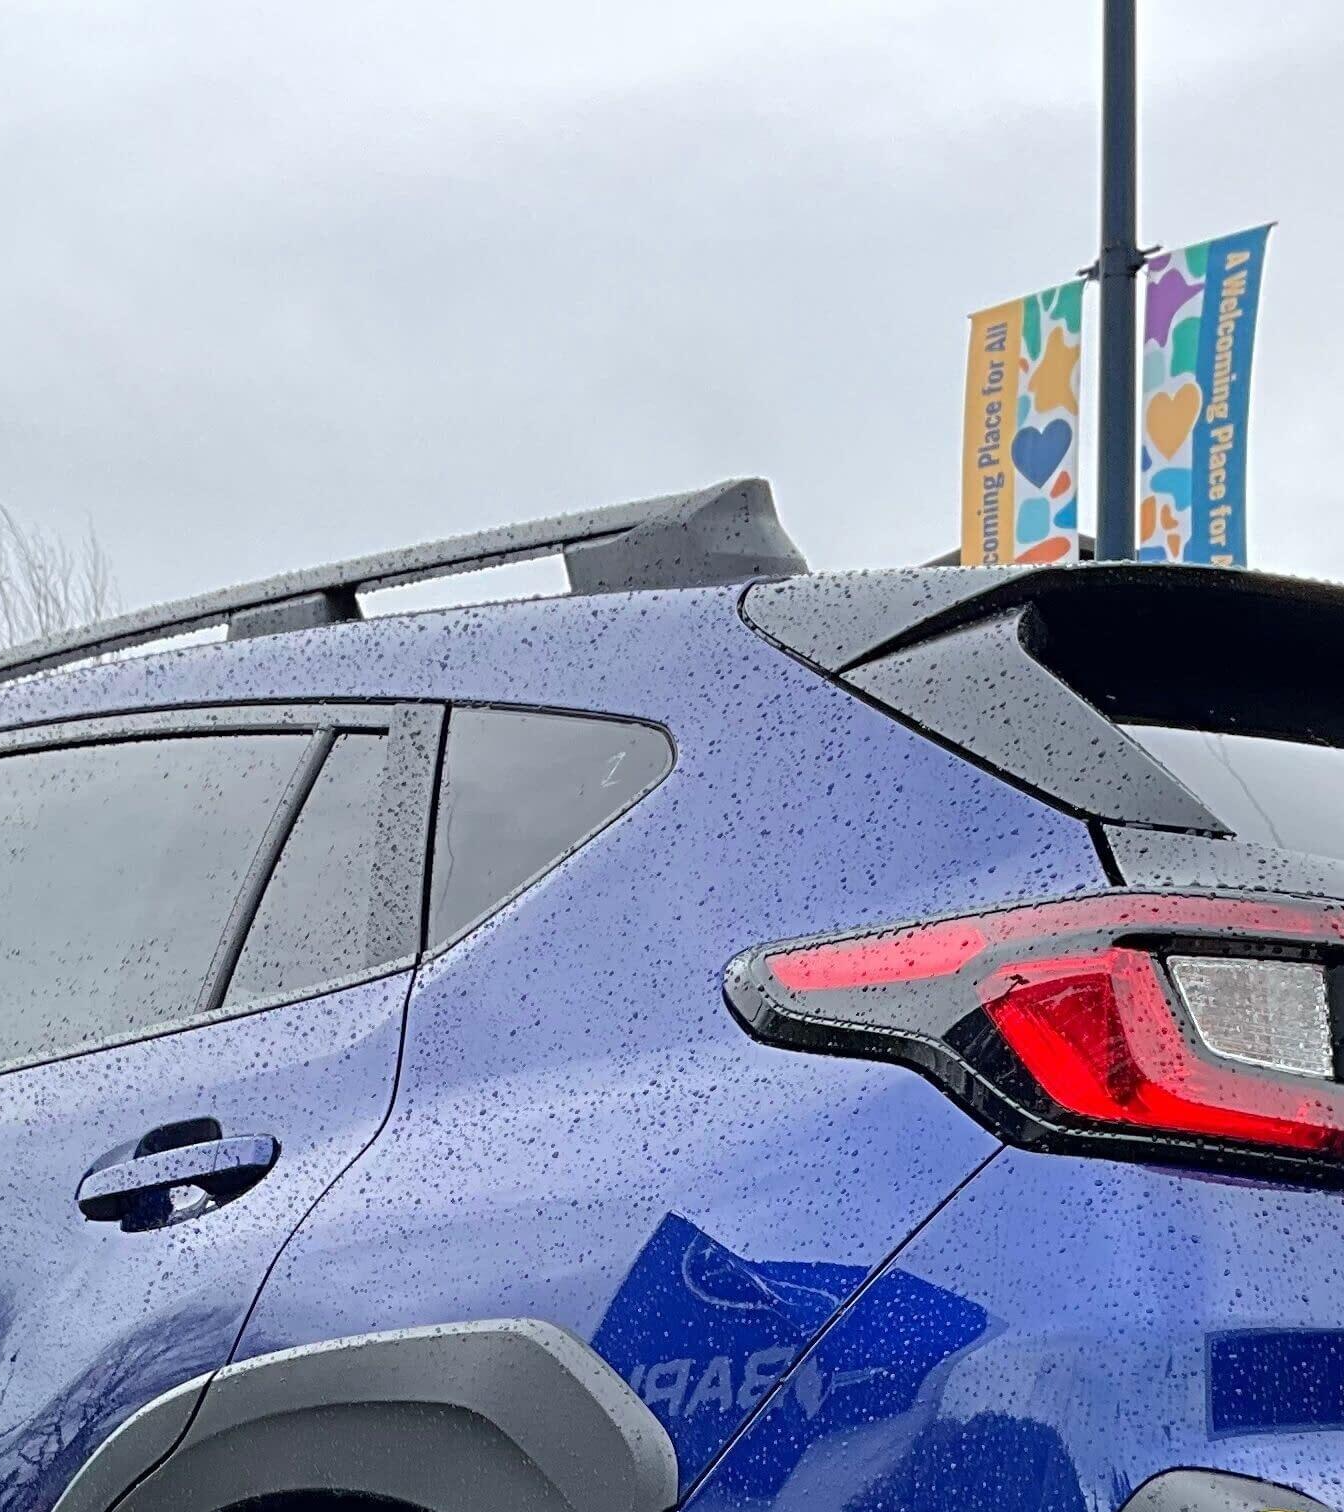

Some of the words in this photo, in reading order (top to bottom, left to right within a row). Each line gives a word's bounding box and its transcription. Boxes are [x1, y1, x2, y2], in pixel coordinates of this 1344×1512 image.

[1225, 251, 1251, 271] A
[984, 321, 1008, 352] All
[1207, 270, 1248, 424] Welcoming
[981, 360, 1005, 396] for
[978, 400, 1002, 469] Place
[1209, 424, 1234, 501] Place
[1209, 504, 1232, 547] for
